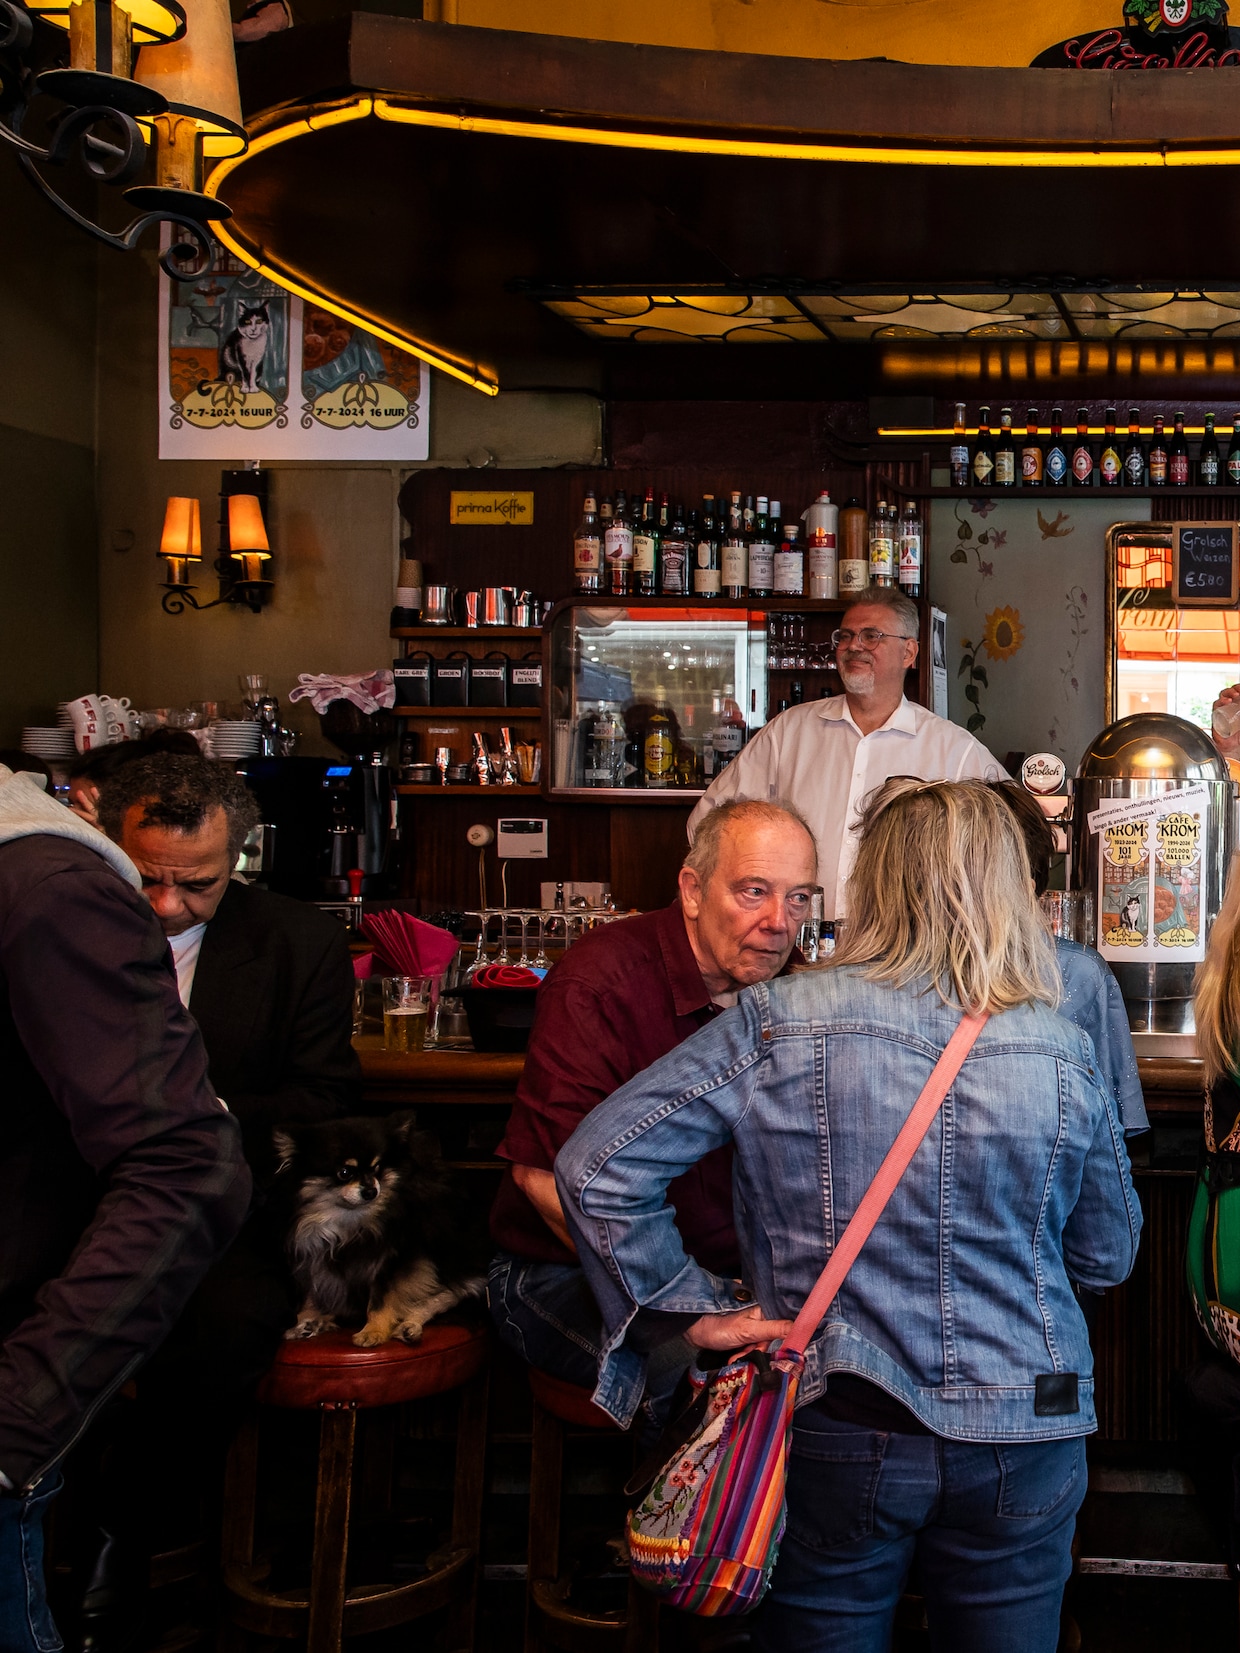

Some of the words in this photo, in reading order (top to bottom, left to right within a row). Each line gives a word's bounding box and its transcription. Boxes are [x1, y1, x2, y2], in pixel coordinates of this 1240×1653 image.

[186, 408, 236, 417] 7-7-2024
[316, 408, 365, 417] 7-7-2024
[370, 408, 382, 417] 16
[384, 408, 405, 416] UUR
[456, 503, 492, 517] prima
[494, 499, 527, 519] Koffie
[1181, 531, 1228, 551] Grolsch
[1026, 763, 1061, 778] Grolsch
[1113, 816, 1129, 825] ander
[1107, 823, 1145, 837] KROM
[1161, 824, 1197, 838] KROM
[1119, 846, 1132, 855] 101
